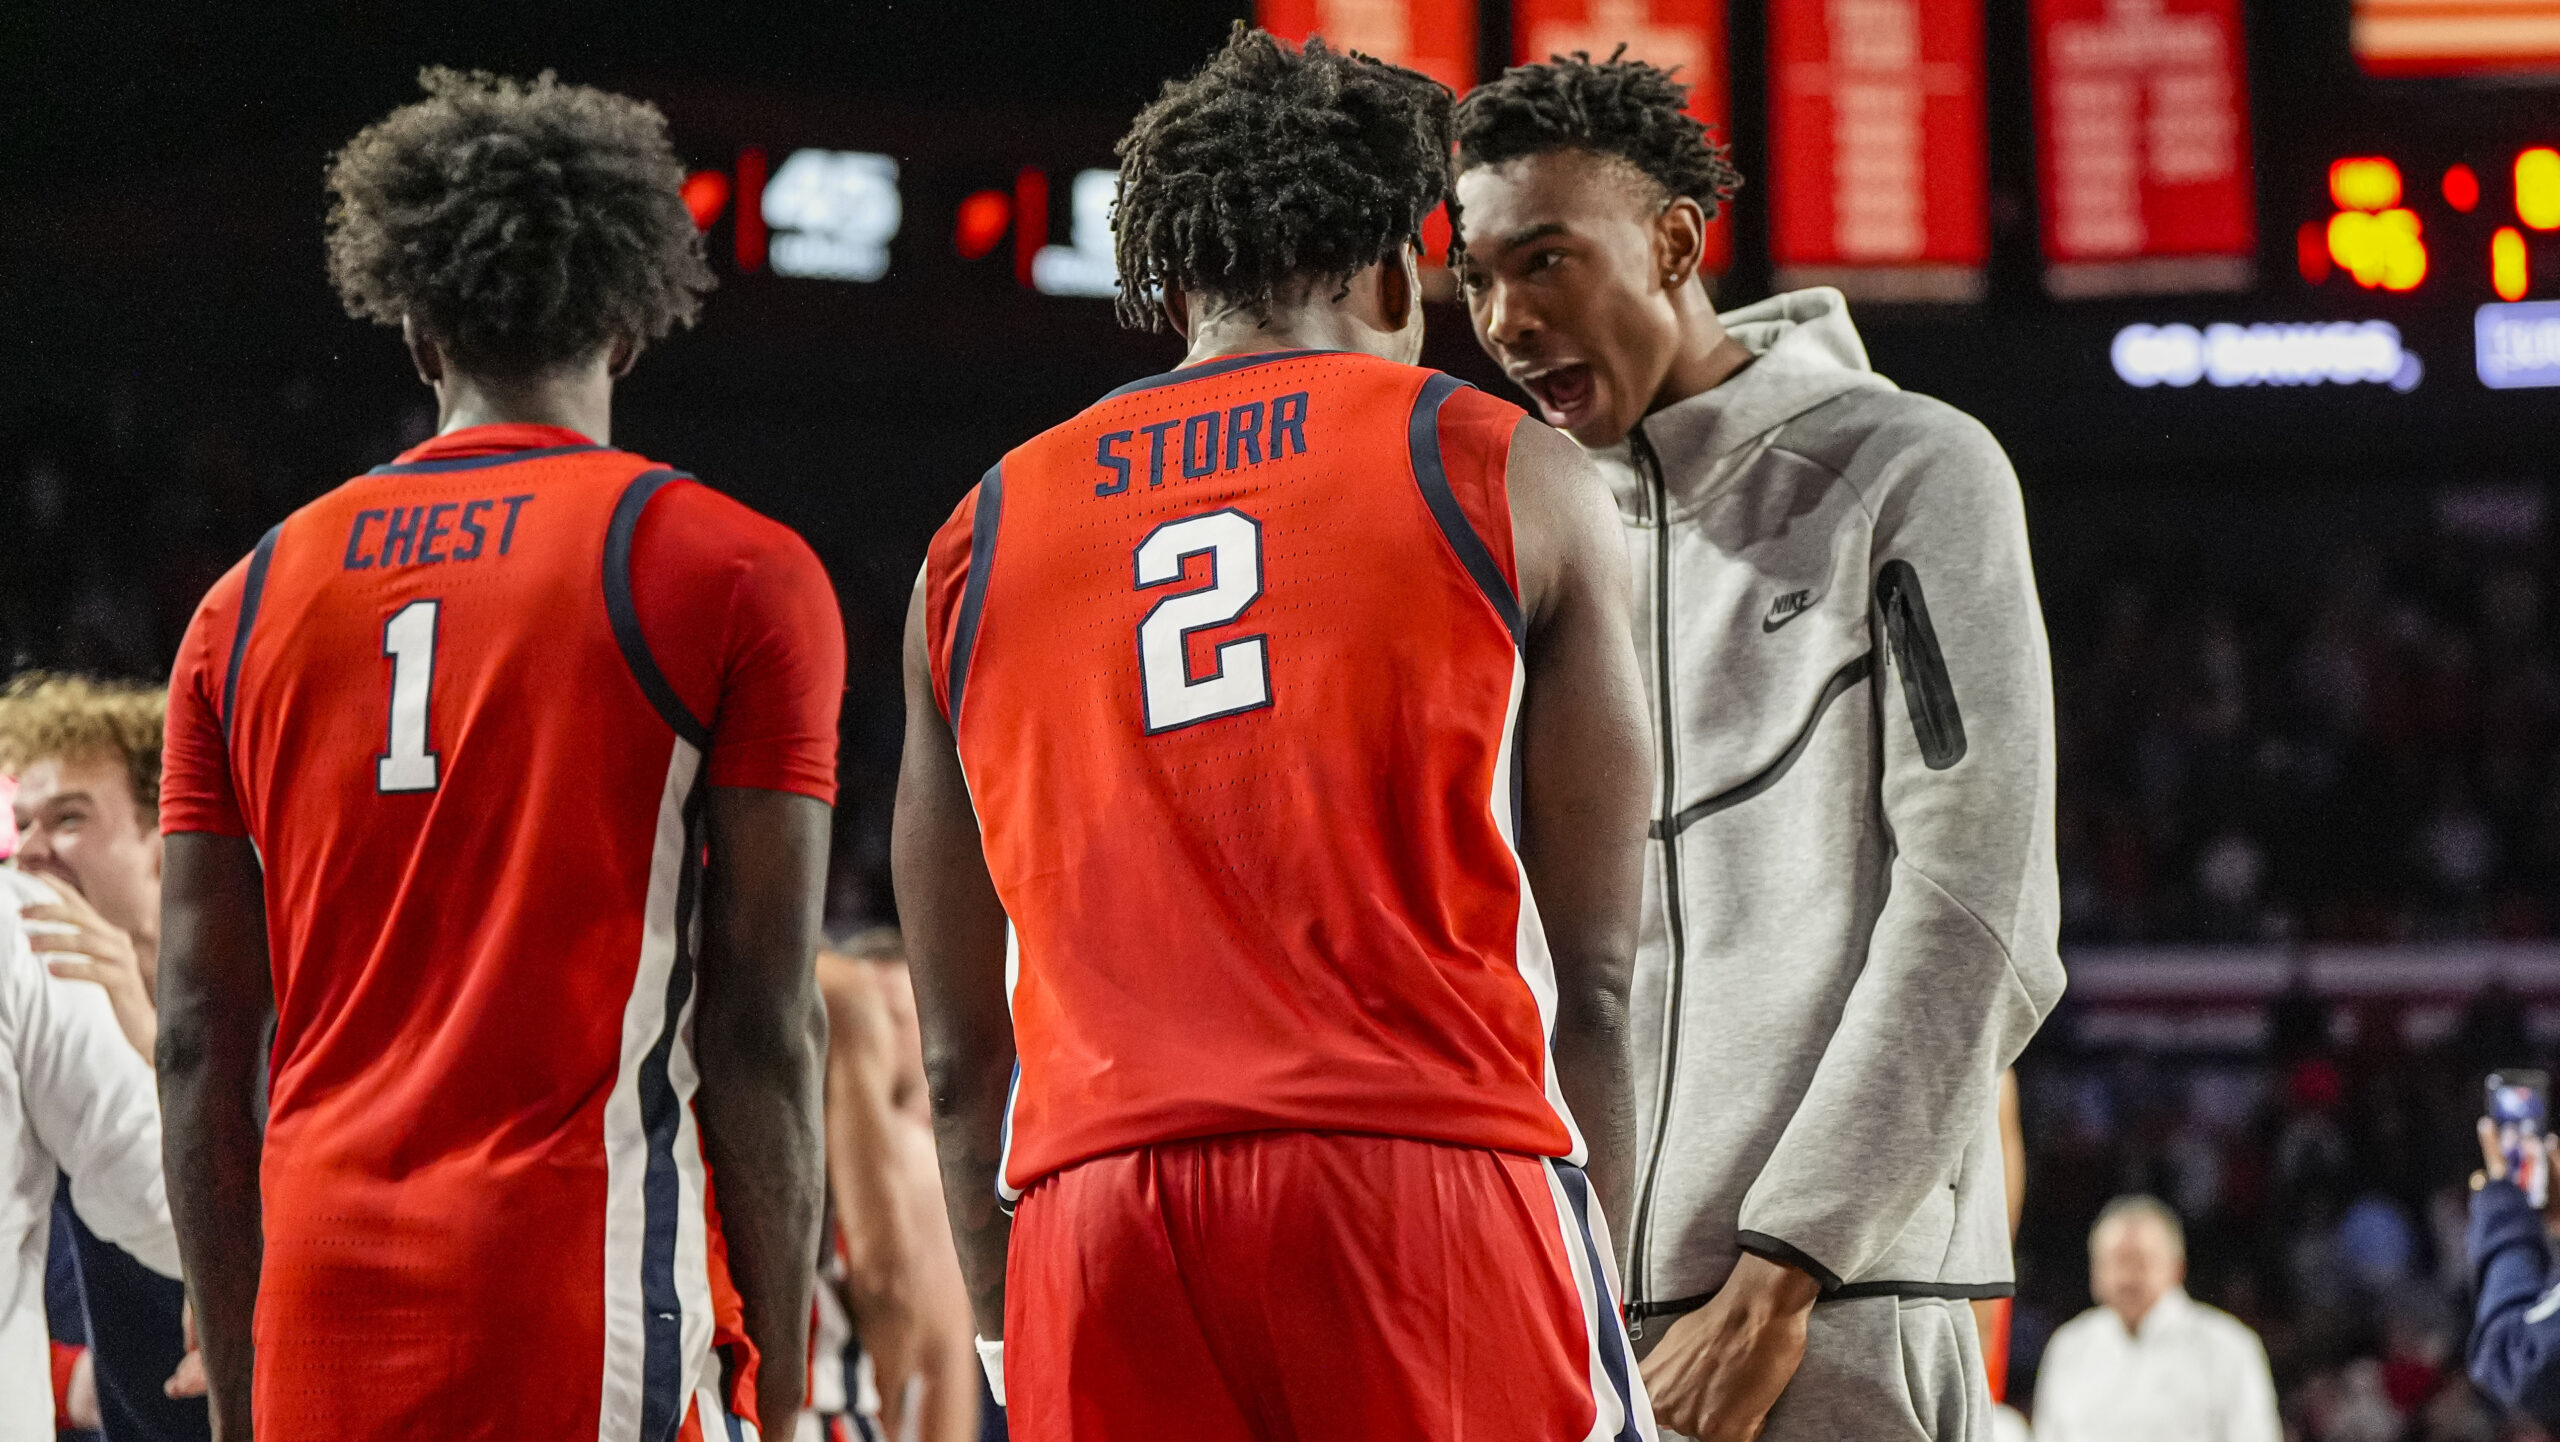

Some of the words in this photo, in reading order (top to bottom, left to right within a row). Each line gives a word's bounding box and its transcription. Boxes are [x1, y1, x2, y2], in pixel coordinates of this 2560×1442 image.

[1095, 391, 1309, 497] STORR
[343, 494, 535, 570] CHEST
[1133, 507, 1275, 737] 2
[1770, 588, 1811, 615] NIKE
[376, 598, 442, 795] 1
